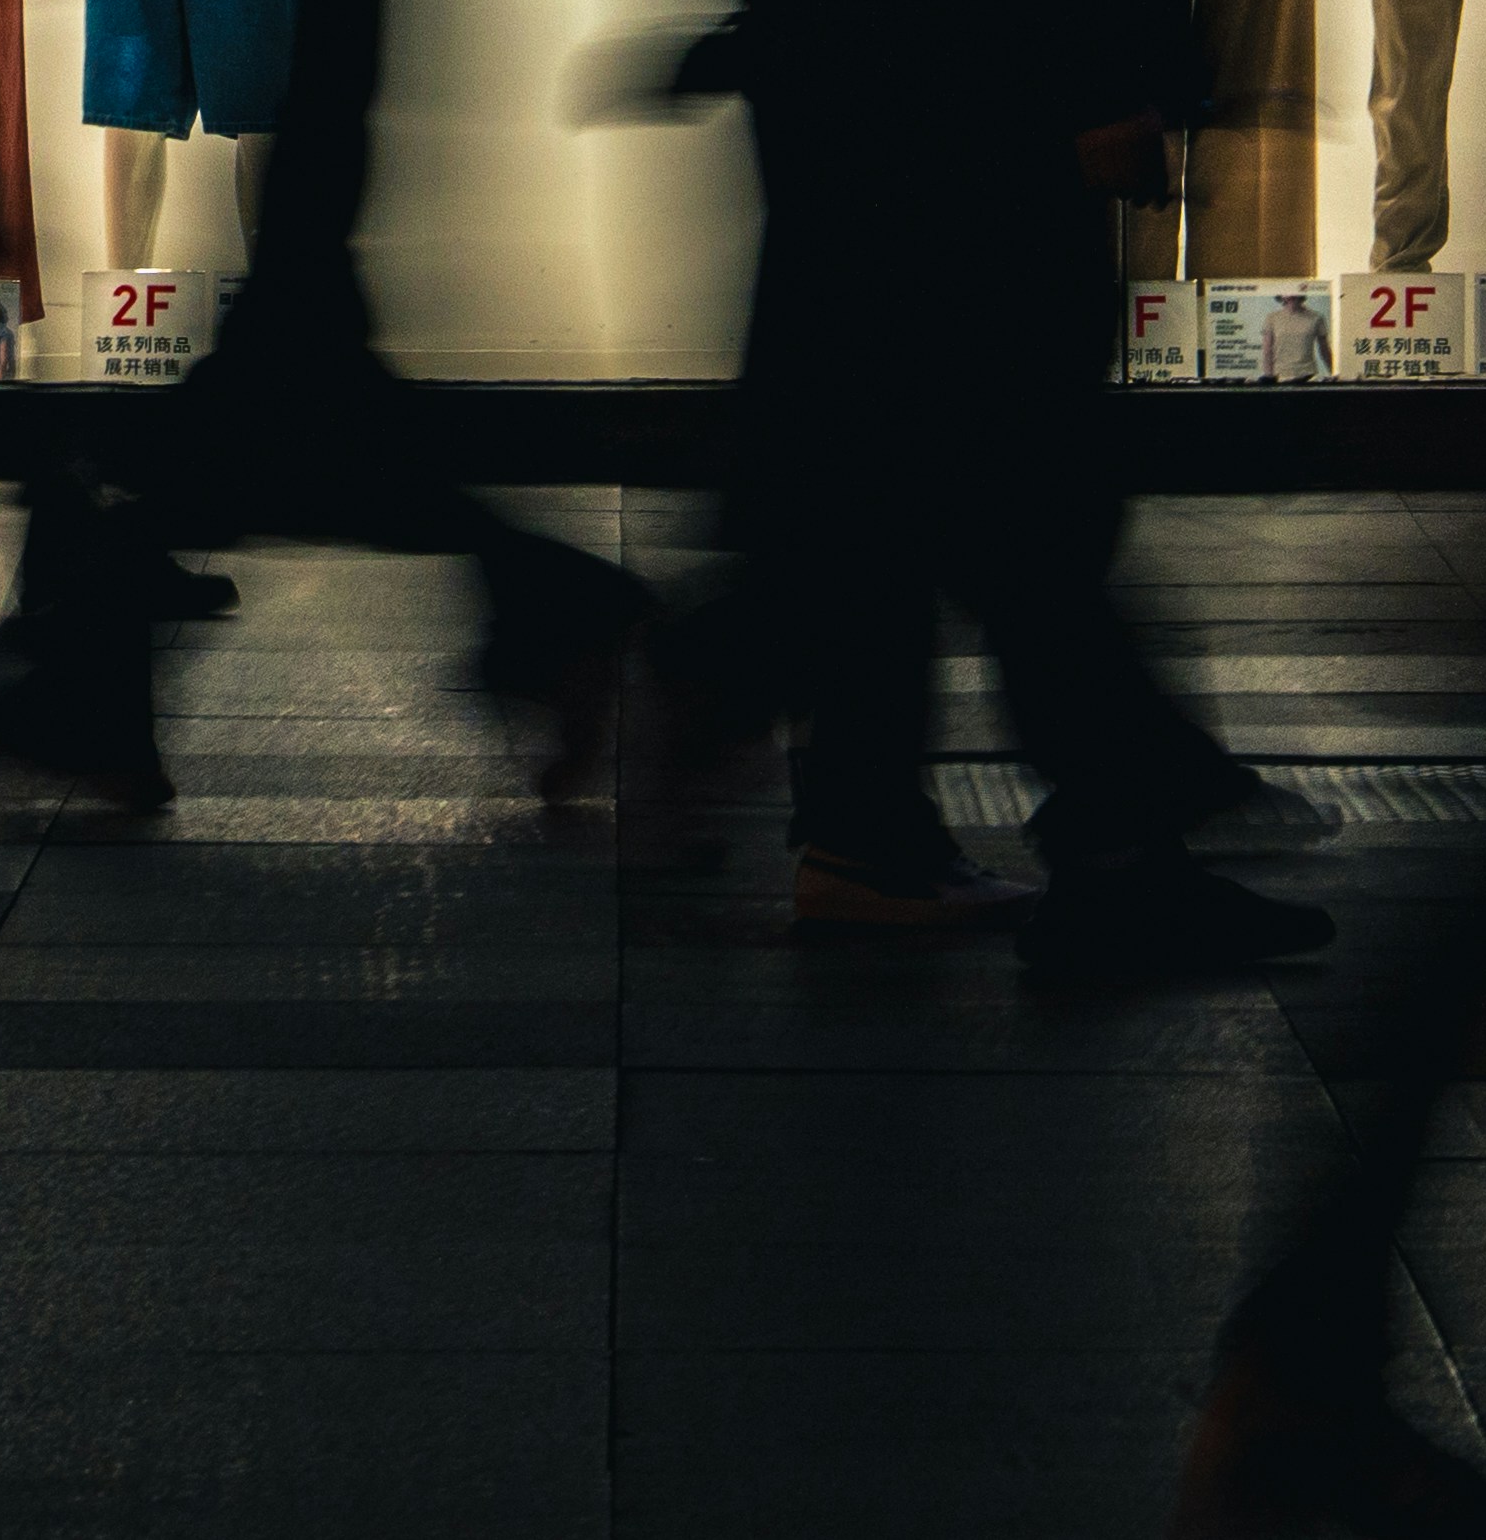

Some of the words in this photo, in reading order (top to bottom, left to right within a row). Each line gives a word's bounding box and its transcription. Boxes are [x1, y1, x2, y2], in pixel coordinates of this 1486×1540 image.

[112, 284, 176, 326] 2F
[1370, 286, 1436, 328] 2F
[95, 335, 192, 354] 该系列商品
[1353, 337, 1452, 356] 该系列商品
[104, 357, 181, 376] 展开销售
